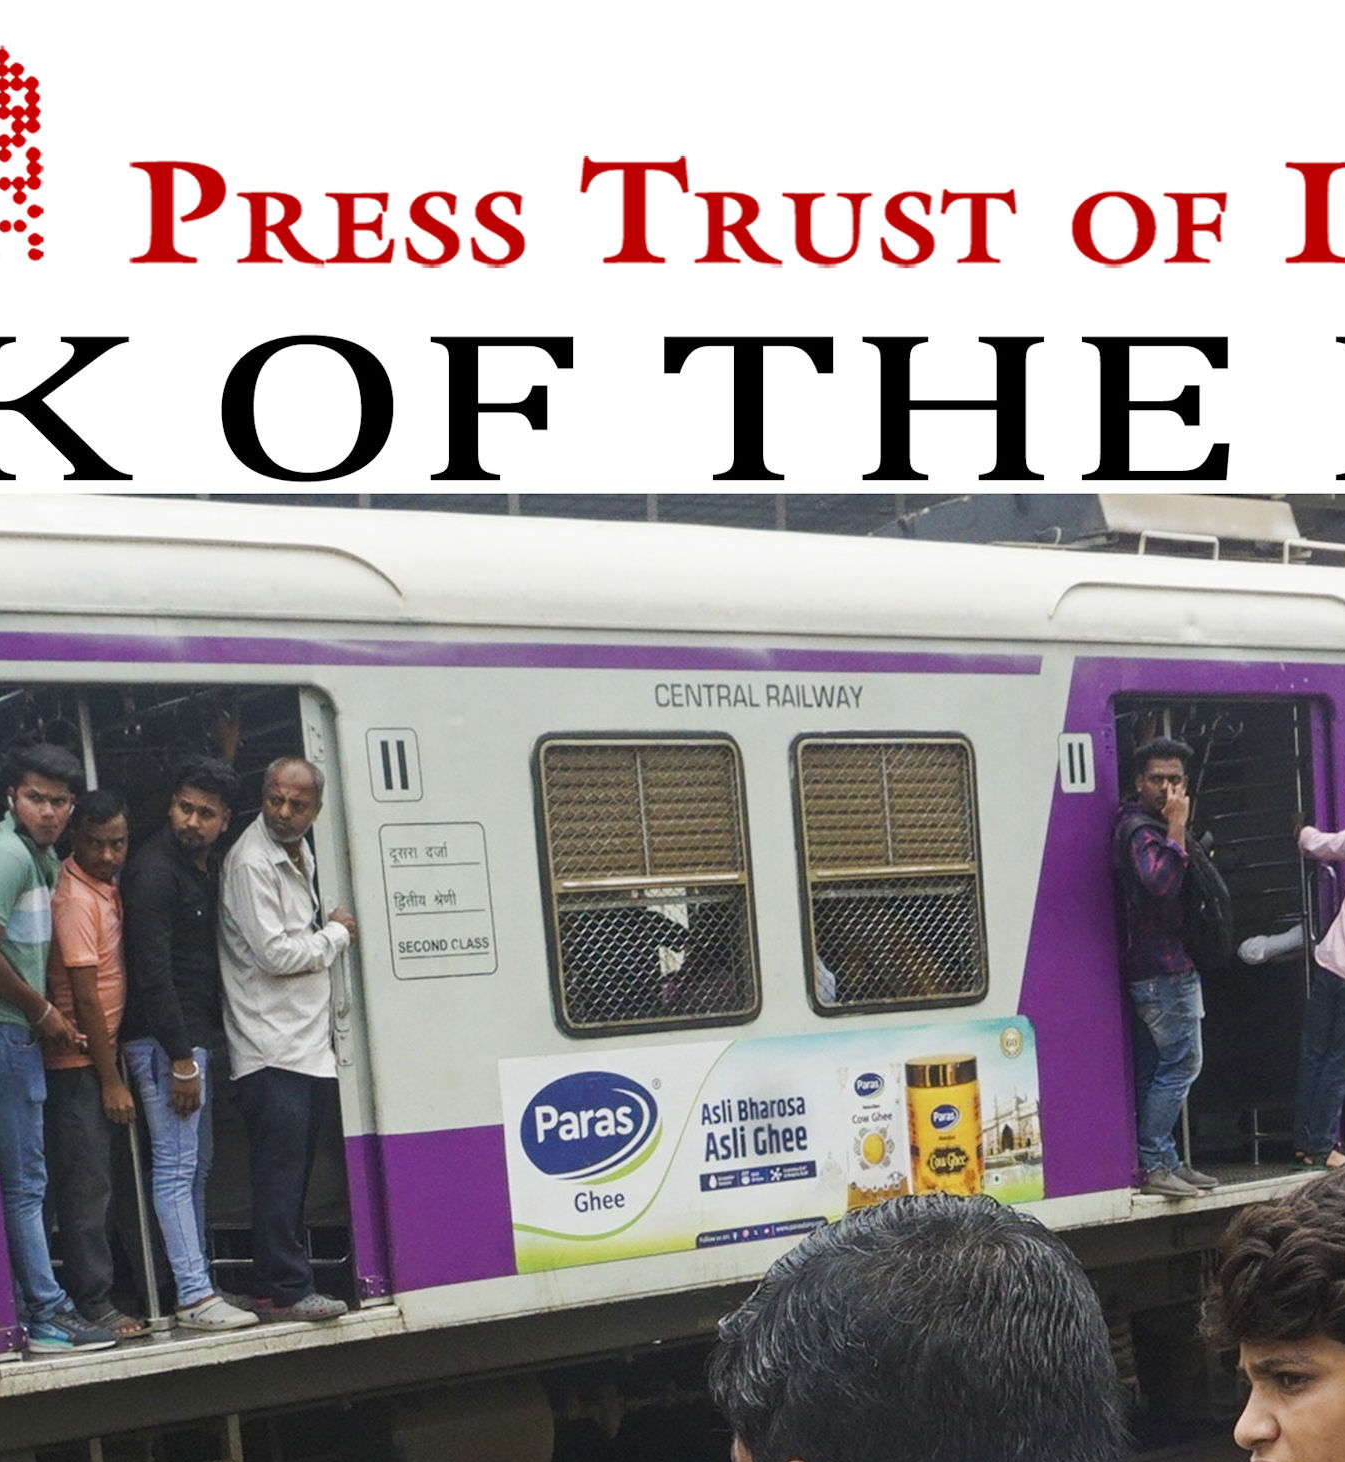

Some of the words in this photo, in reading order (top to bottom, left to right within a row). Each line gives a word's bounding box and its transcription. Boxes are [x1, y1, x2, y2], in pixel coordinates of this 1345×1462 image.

[654, 683, 760, 708] CENTRAL
[766, 684, 863, 709] RAILWAY
[389, 846, 418, 864] दूसरा
[434, 888, 457, 906] श्रेणी
[398, 938, 448, 954] SECOND
[451, 937, 490, 951] CLASS
[701, 1101, 732, 1126] Asli
[738, 1096, 806, 1120] Bharosa
[534, 1105, 635, 1144] Paras
[705, 1127, 746, 1162] Asli
[753, 1123, 808, 1151] Ghee
[574, 1190, 626, 1213] Ghee
